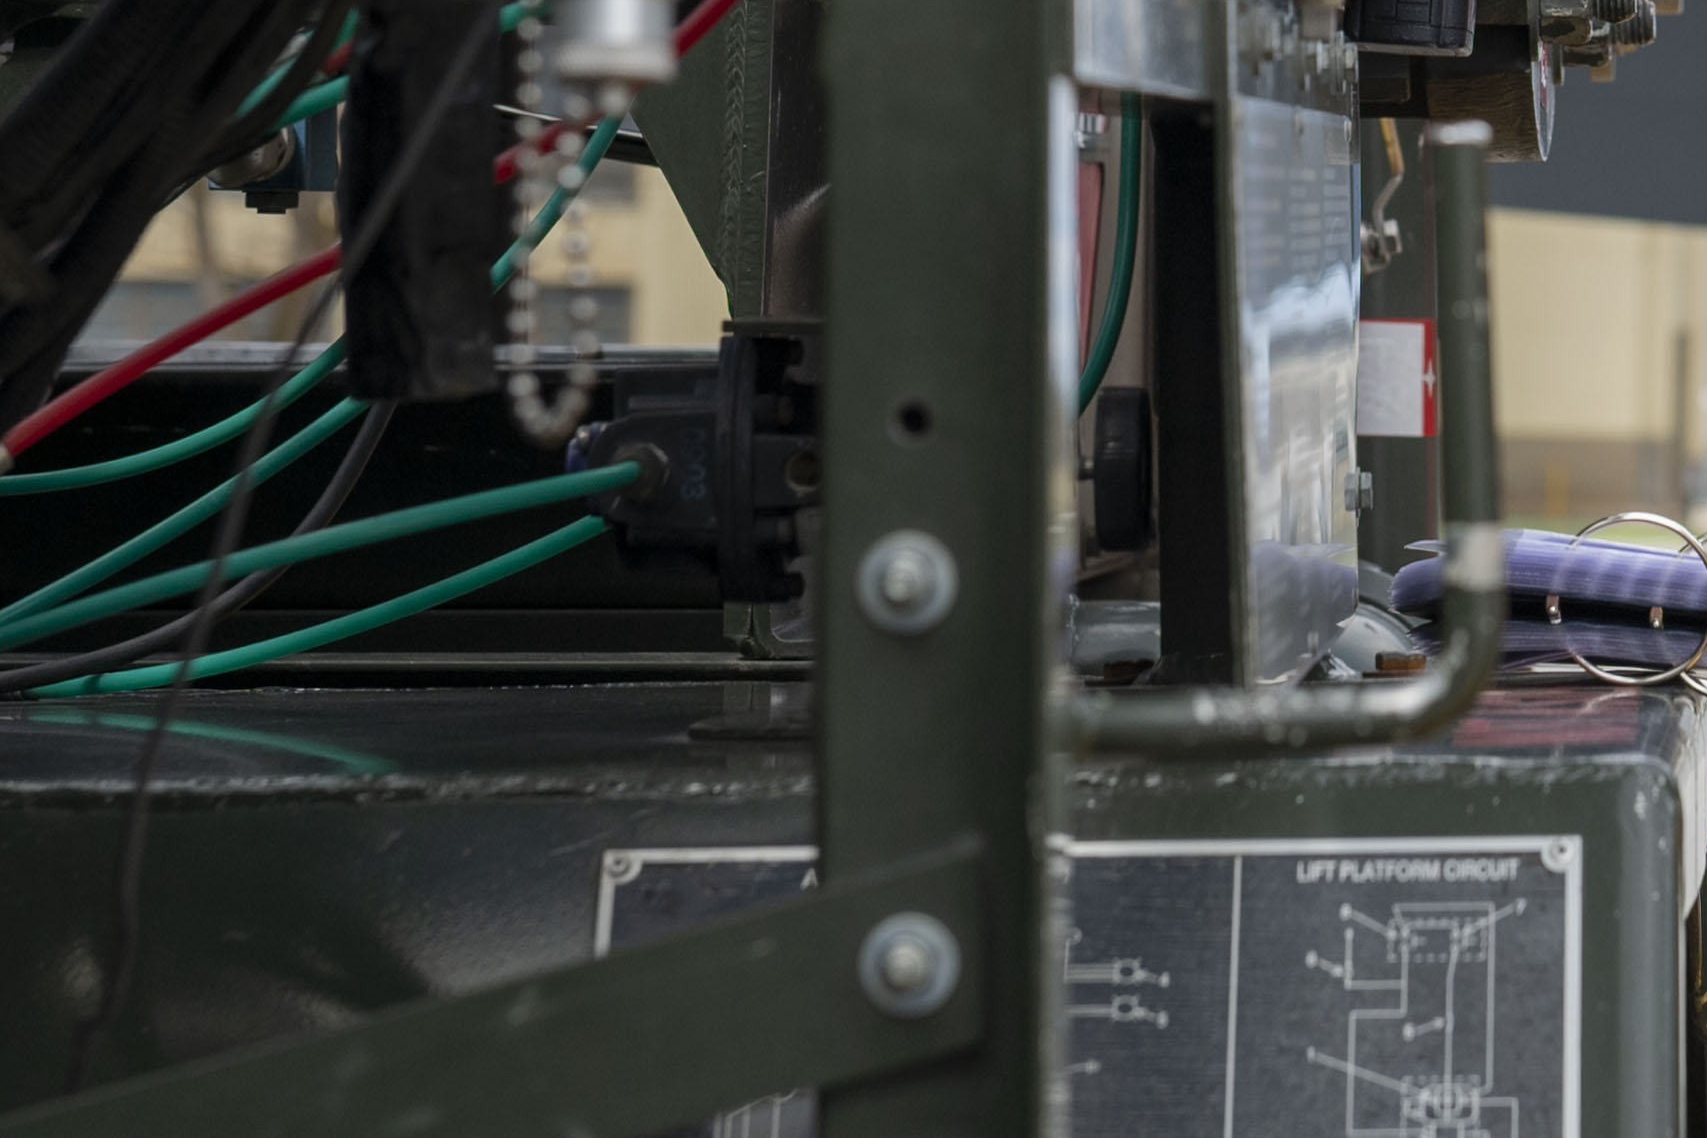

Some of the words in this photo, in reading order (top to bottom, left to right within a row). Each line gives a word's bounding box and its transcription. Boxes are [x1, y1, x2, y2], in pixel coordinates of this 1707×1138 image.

[1296, 859, 1337, 884] LIFT
[1338, 858, 1441, 884] PLATFORM
[1443, 857, 1521, 883] CIRCUIT
